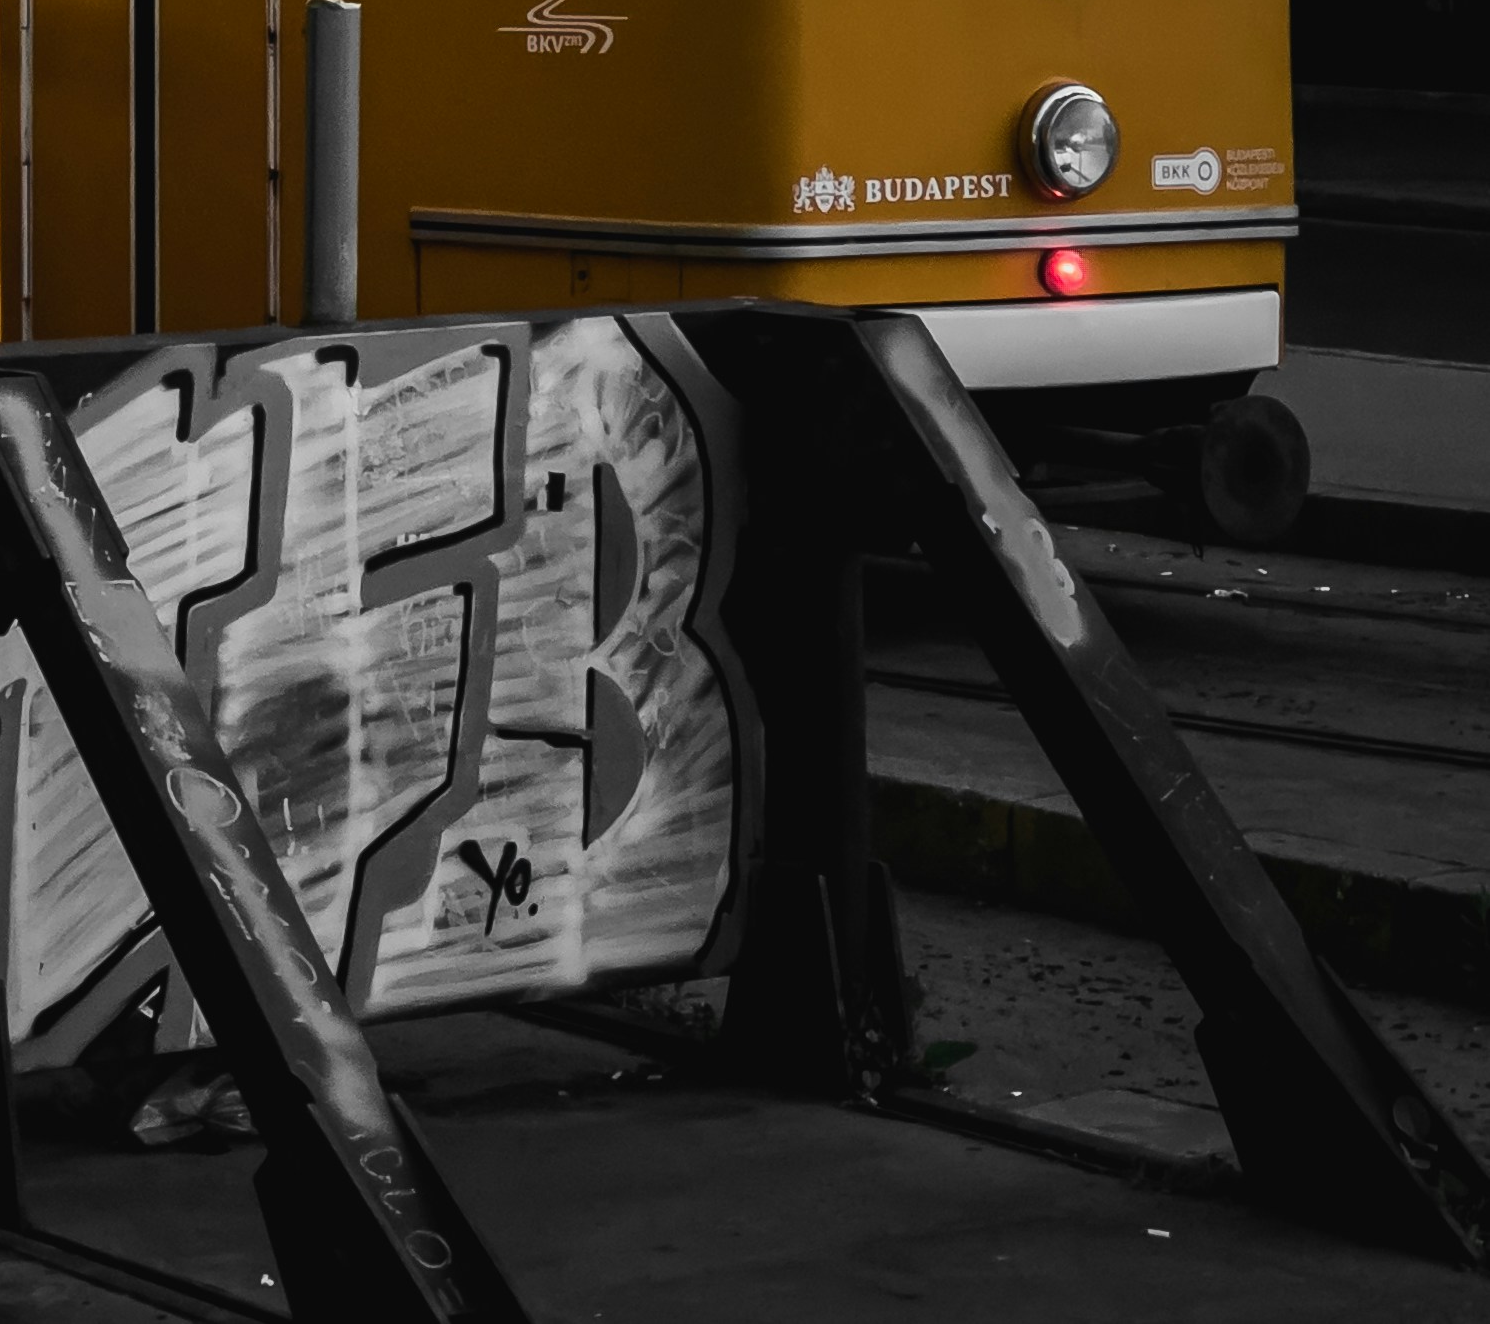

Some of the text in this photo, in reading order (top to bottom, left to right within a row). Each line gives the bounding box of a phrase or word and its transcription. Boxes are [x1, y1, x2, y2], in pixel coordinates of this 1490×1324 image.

[527, 34, 564, 53] BKV
[1162, 164, 1191, 184] BKK
[865, 174, 1012, 203] BUDAPEST
